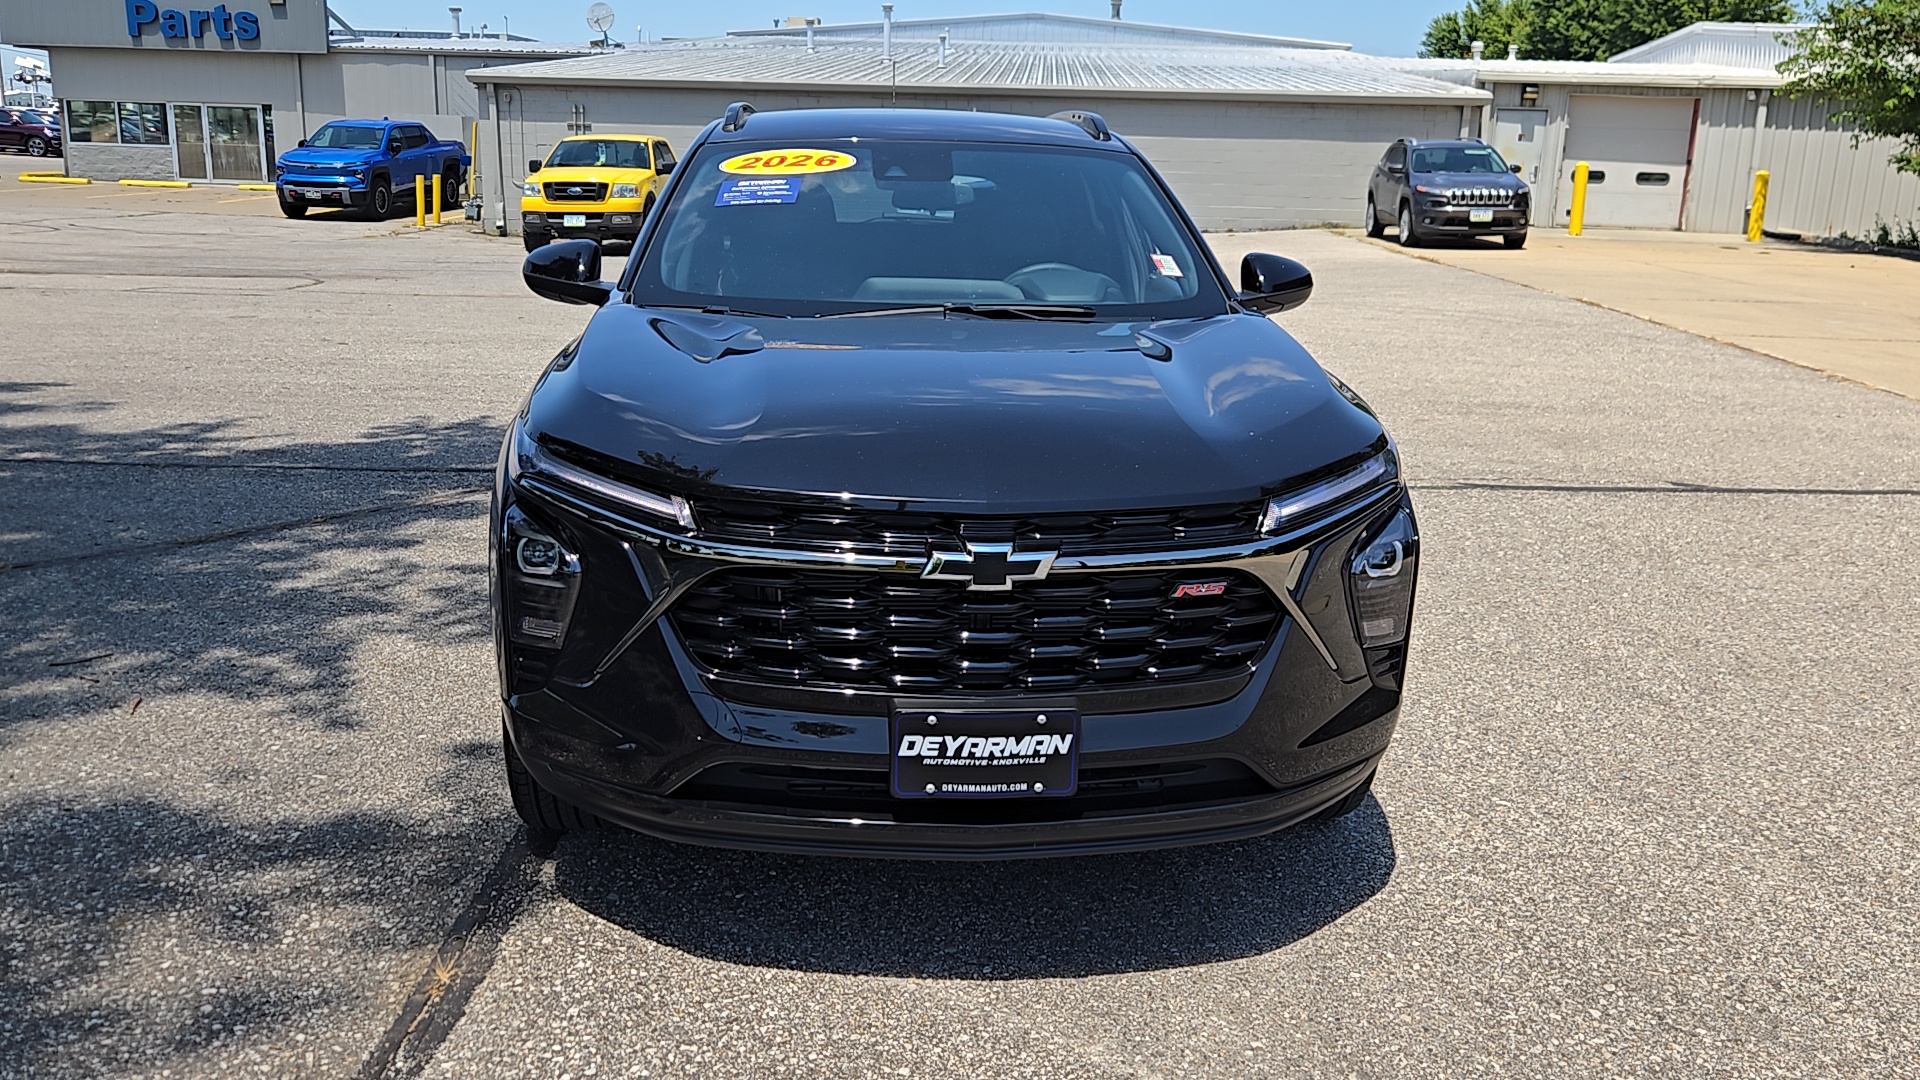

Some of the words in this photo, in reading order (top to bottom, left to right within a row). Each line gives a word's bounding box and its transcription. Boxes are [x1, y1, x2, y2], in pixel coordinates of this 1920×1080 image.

[125, 0, 259, 40] Parts
[735, 155, 840, 170] 2026
[1170, 582, 1227, 598] RS
[898, 734, 1073, 757] DEYARMAN
[941, 783, 1028, 792] DEYARMANAUTO.COM
